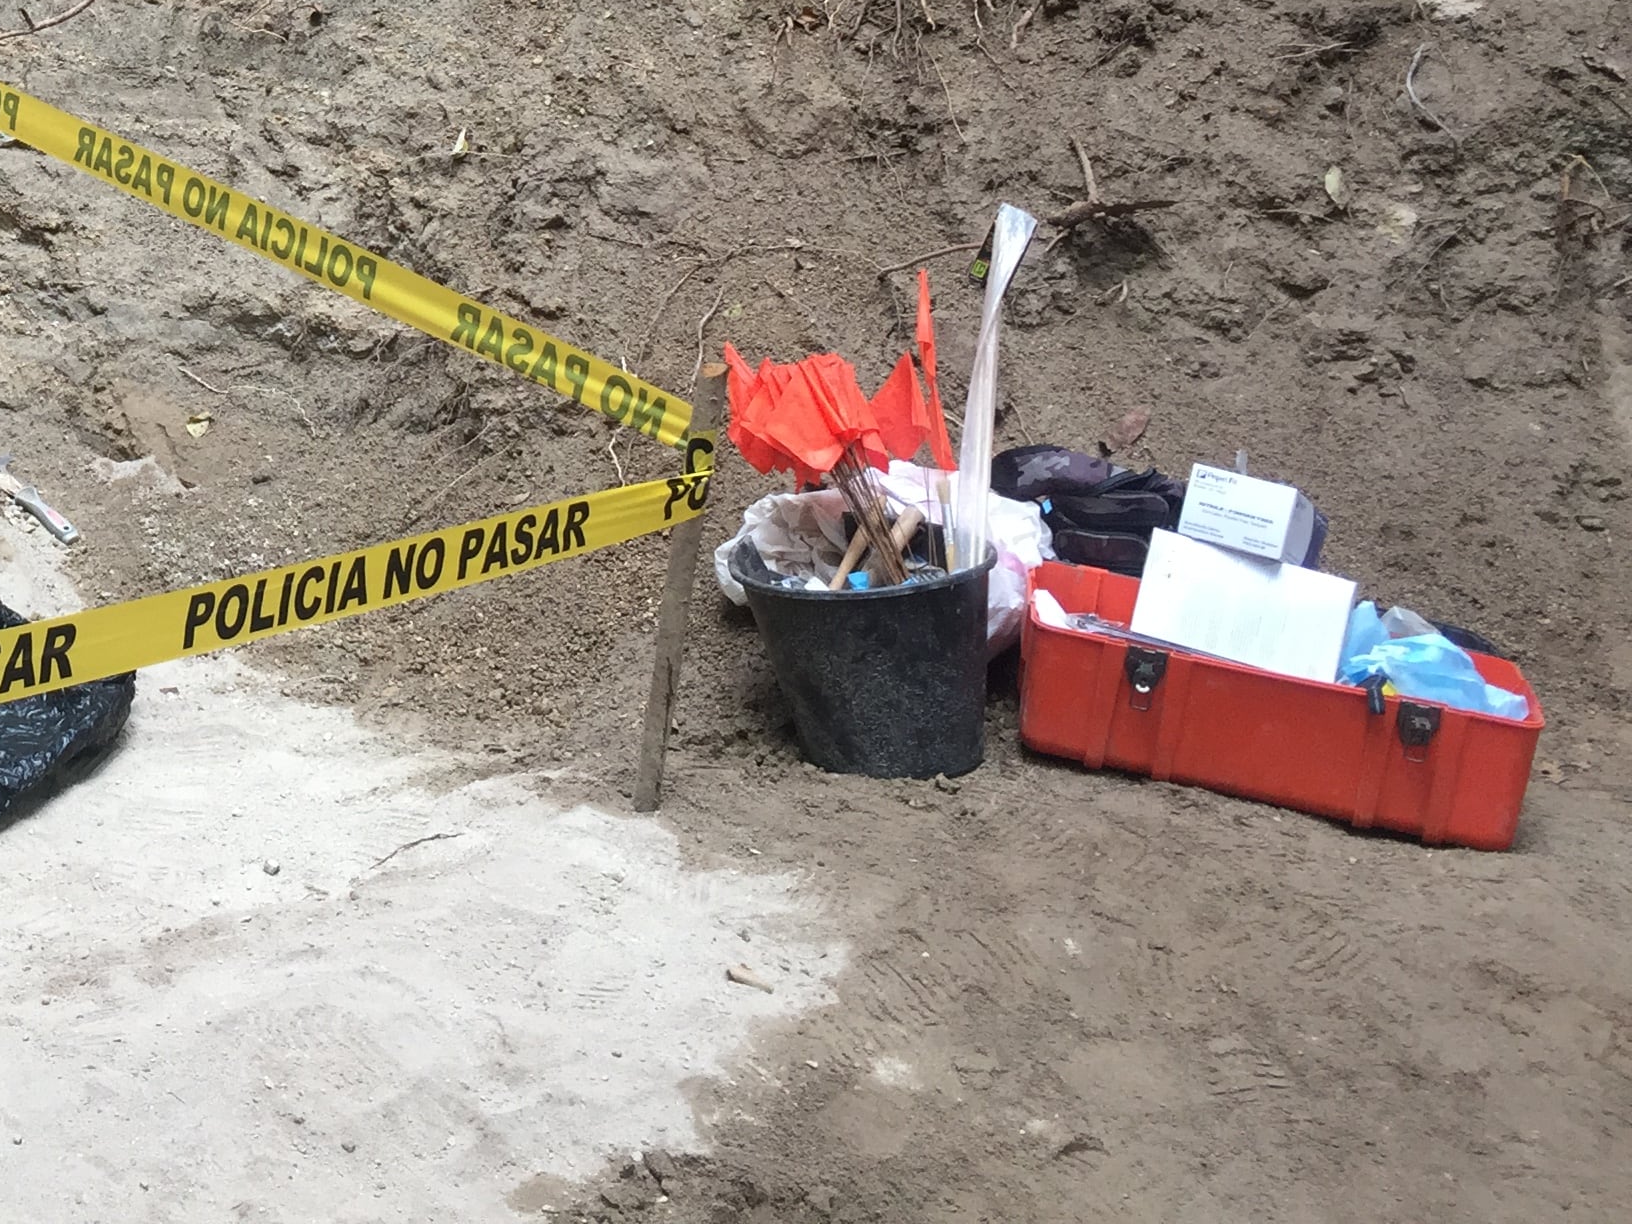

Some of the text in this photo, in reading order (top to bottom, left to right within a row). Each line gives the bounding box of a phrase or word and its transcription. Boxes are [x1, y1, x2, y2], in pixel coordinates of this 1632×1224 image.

[183, 501, 590, 650] POLICIA NO PASAR
